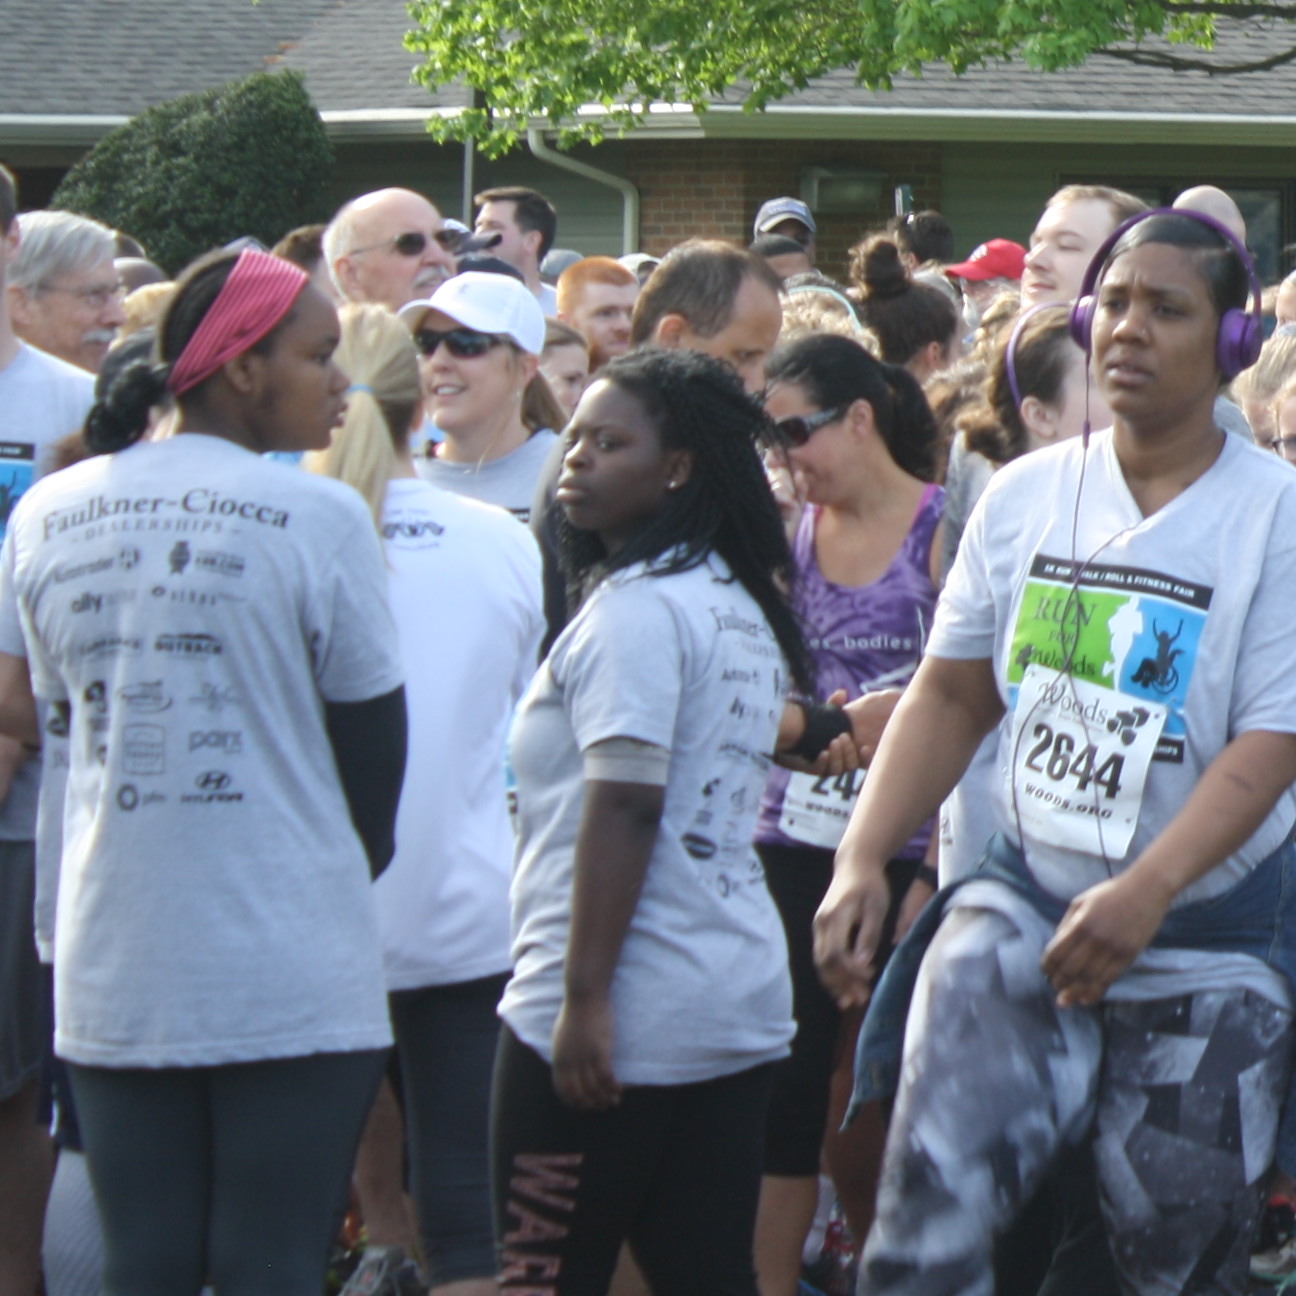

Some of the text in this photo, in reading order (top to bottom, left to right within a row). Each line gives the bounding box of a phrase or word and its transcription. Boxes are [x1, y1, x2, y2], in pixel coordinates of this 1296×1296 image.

[42, 488, 290, 541] Faulkner-Ciocca
[84, 518, 224, 542] DEALERSHIPS
[844, 635, 912, 650] bodies
[1038, 682, 1109, 724] Woods
[1024, 722, 1126, 800] 2644
[1024, 782, 1114, 820] WOODS.ORG
